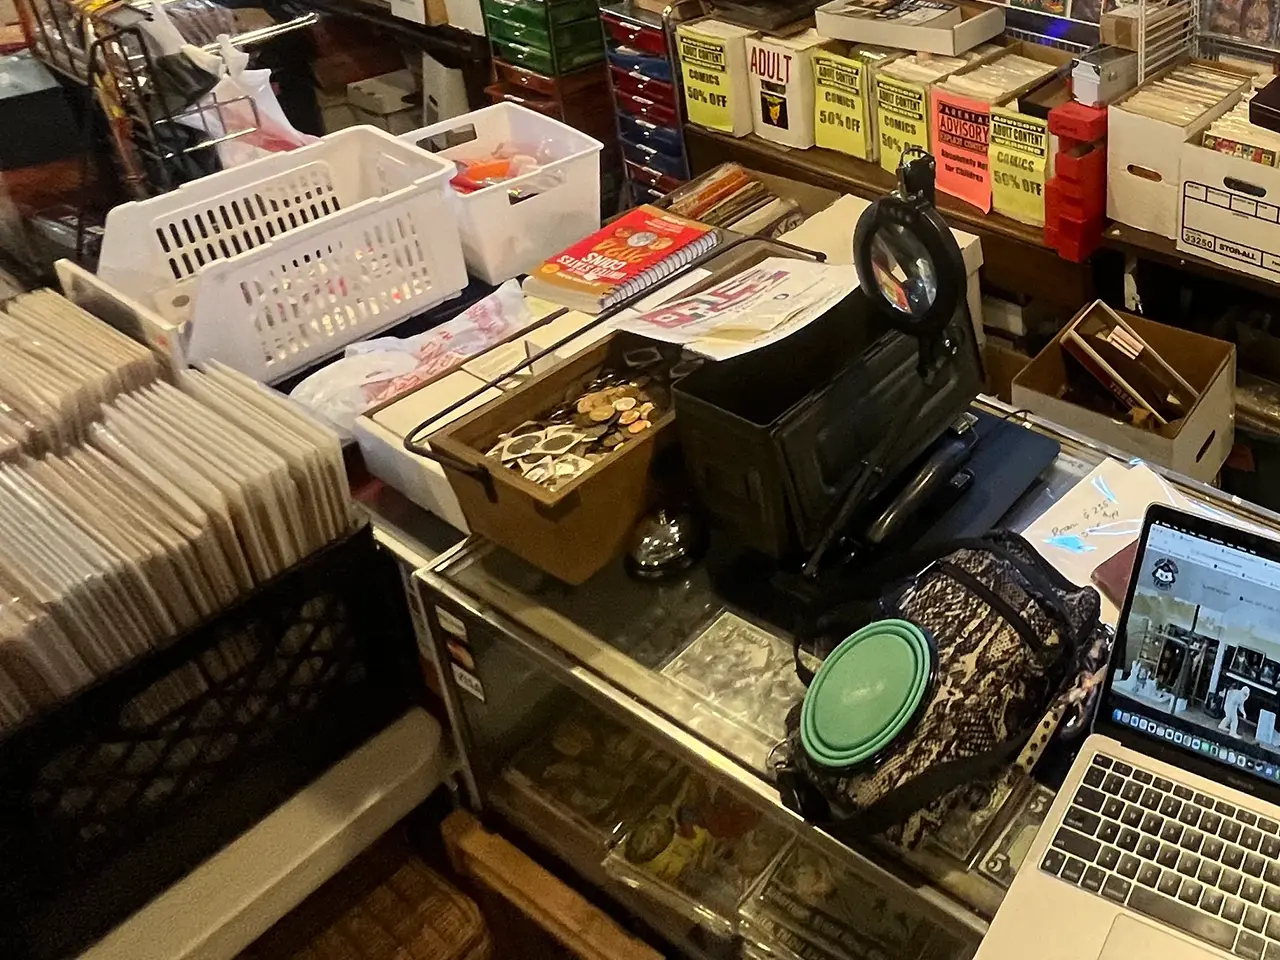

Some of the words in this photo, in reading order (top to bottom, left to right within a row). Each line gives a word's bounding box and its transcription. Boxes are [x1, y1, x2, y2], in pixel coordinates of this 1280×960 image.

[750, 46, 793, 84] ADULT
[688, 68, 720, 86] COMICS
[687, 86, 708, 104] 50%
[708, 92, 728, 108] OFF
[825, 91, 856, 110] COMICS
[895, 93, 921, 112] CONTENT
[819, 110, 844, 128] 50%
[845, 116, 861, 133] OFF
[884, 115, 917, 135] COMICS
[940, 115, 990, 143] ADVISORY
[993, 115, 1044, 133] ADVISORY
[881, 132, 902, 153] 50%
[993, 123, 1012, 139] ADULT
[1013, 128, 1043, 147] CONTENT
[996, 151, 1035, 173] COMICS
[993, 169, 1021, 190] 50%
[1022, 178, 1042, 196] OFF
[1184, 232, 1213, 249] 33250
[580, 252, 628, 271] COINS
[1218, 243, 1257, 261] STOR-ALL
